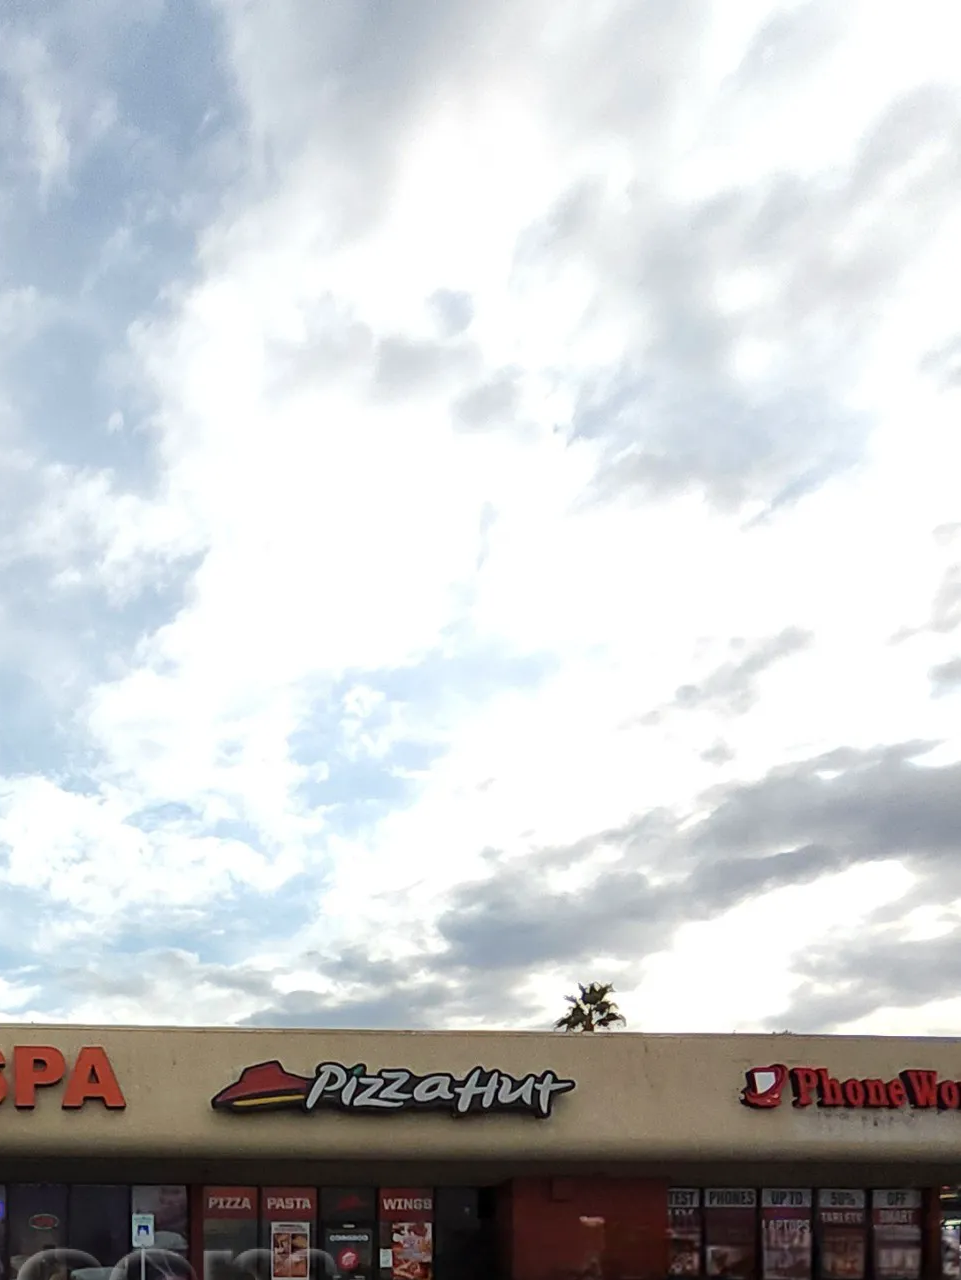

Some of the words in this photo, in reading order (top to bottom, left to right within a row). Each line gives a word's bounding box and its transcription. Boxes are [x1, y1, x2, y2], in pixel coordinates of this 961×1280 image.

[900, 1069, 961, 1111] Wo
[208, 1197, 252, 1211] PIZZA
[267, 1197, 312, 1211] PASTA
[383, 1197, 433, 1211] WINGS
